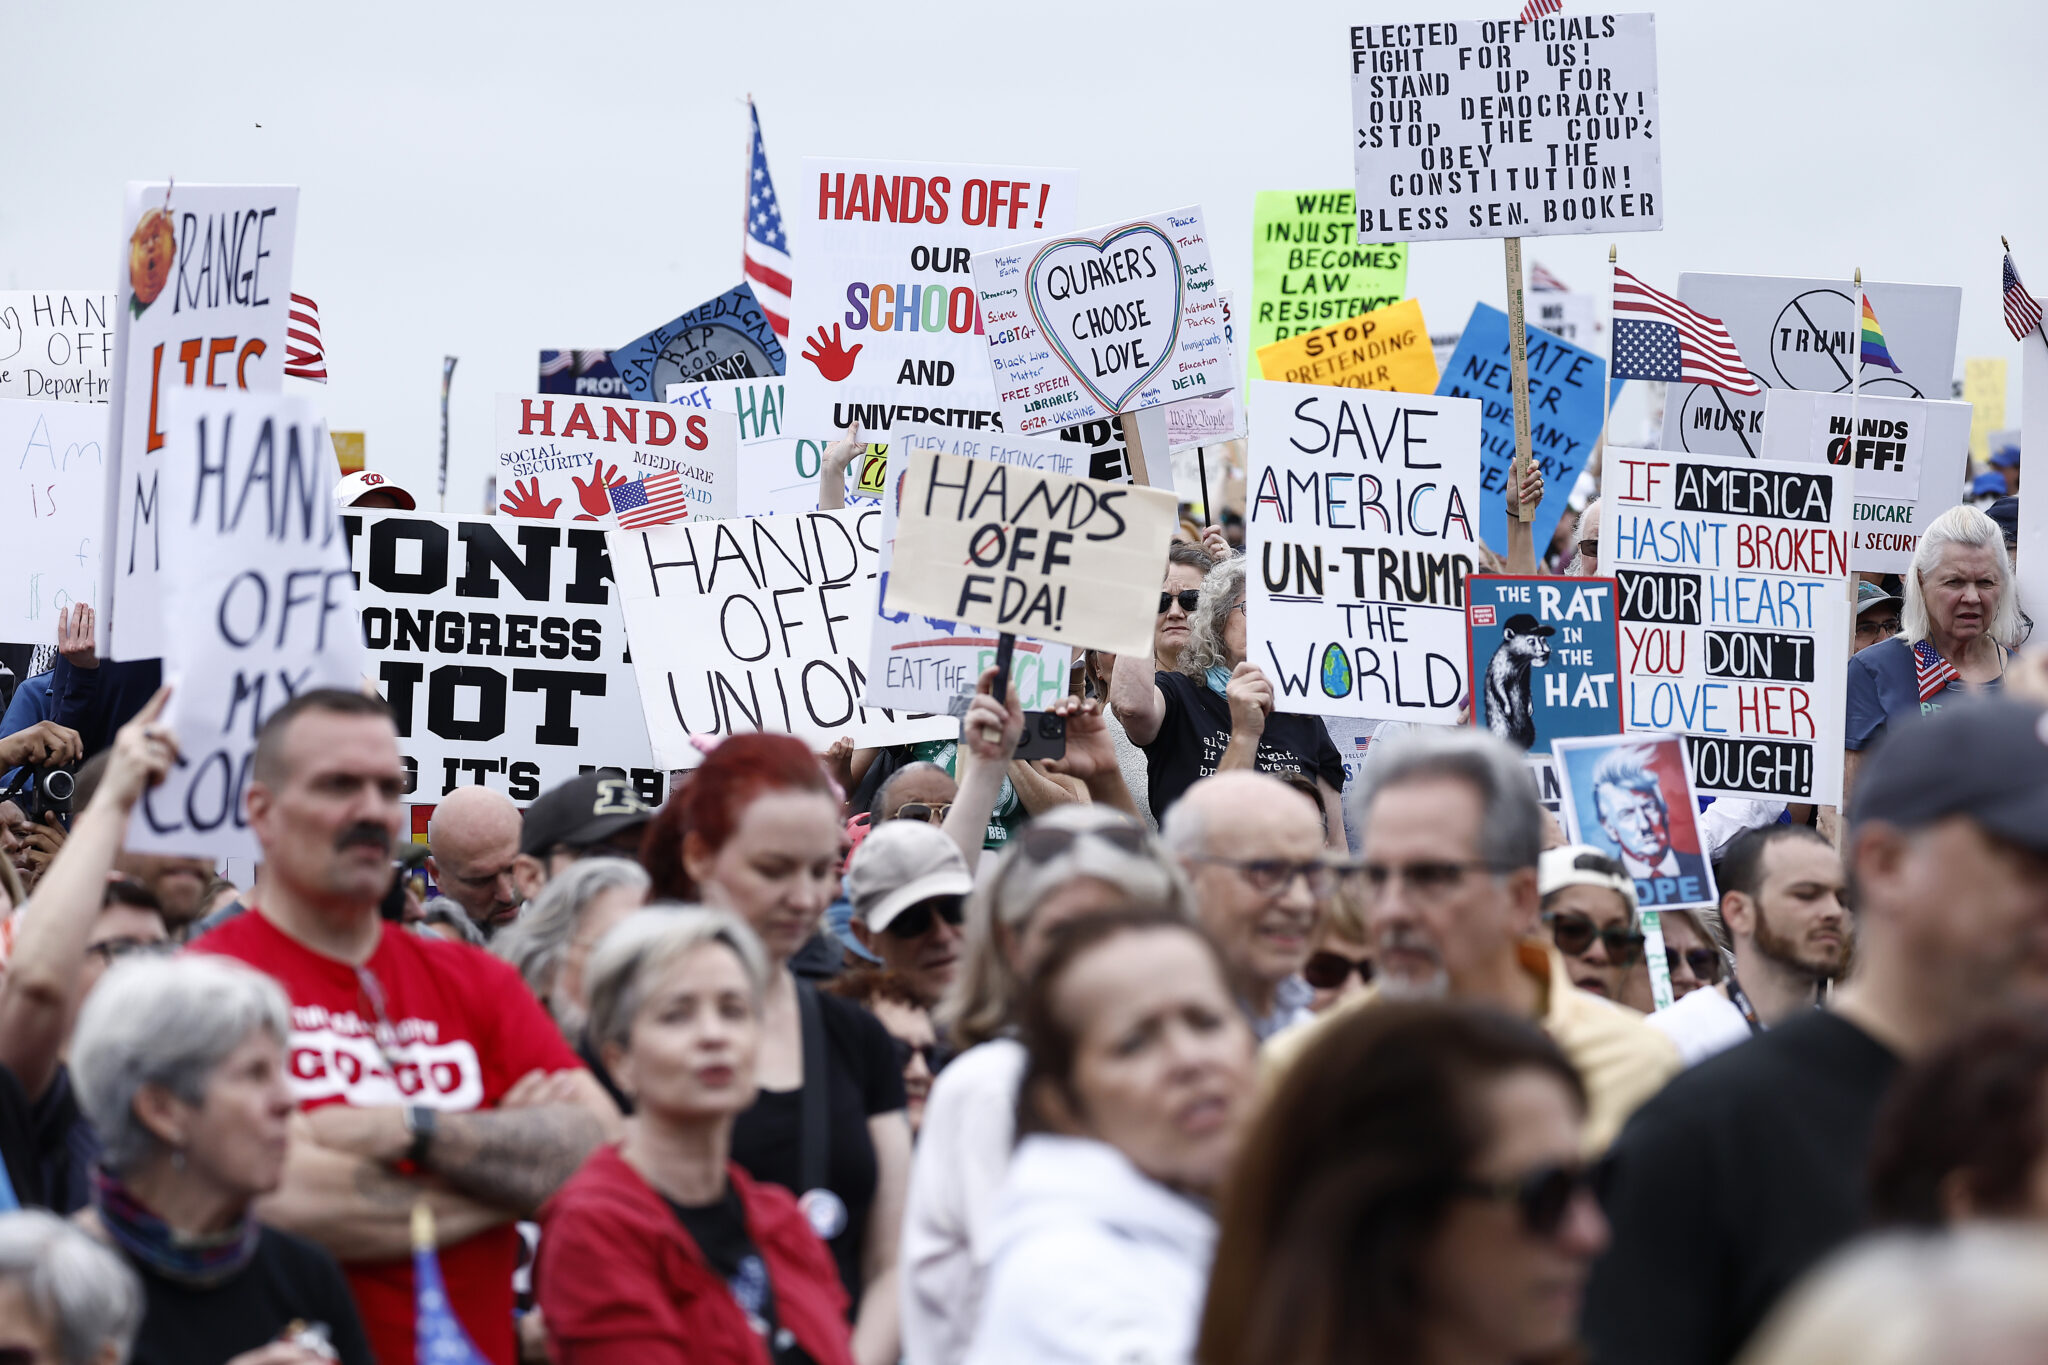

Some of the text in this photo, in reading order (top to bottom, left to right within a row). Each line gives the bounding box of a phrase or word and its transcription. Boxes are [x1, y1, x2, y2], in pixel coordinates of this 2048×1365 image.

[1350, 15, 1615, 49] ELECTED OFFICIALS
[1353, 43, 1590, 73] FIGHT FOR US!
[1370, 68, 1611, 98] STAND UP FOR
[1370, 91, 1644, 123] OUR DEMOCRACY!
[1481, 119, 1532, 144] THE
[1421, 143, 1598, 170] OBEY THE
[1390, 166, 1630, 197] CONSTITUTION!
[819, 172, 1050, 229] HANDS OFF!
[1296, 193, 1356, 215] WHE
[1360, 193, 1654, 232] BLESS SEN. BOOKER
[1167, 216, 1198, 228] Peace
[911, 245, 970, 274] OUR
[1177, 236, 1203, 249] Truth
[1289, 249, 1400, 270] BECOMES
[999, 267, 1020, 278] Earth
[1047, 246, 1157, 301] QUAKERS
[1183, 263, 1208, 277] Park
[33, 295, 118, 328] HAN
[682, 291, 785, 363] MEDICAID
[988, 309, 1018, 323] Science
[1072, 299, 1152, 340] CHOOSE
[1185, 317, 1216, 329] Parks
[48, 332, 115, 367] OFF
[658, 327, 715, 368] RIP
[989, 325, 1036, 346] LGBTQ+
[1305, 320, 1377, 356] STOP
[1781, 327, 1856, 354] TRUM
[622, 327, 671, 392] SAVE
[897, 359, 955, 387] AND
[994, 351, 1050, 371] Black Lives
[1091, 338, 1150, 378] LOVE
[1286, 329, 1418, 383] PRETENDING
[1001, 376, 1070, 402] FREE SPEECH
[1172, 373, 1207, 391] DEIA
[1024, 390, 1080, 413] LIBRARIES
[518, 399, 709, 451] HANDS
[1290, 396, 1442, 469] SAVE
[1693, 406, 1764, 434] MUSK
[1829, 416, 1909, 440] HANDS
[500, 443, 561, 467] SOCIAL
[1530, 422, 1580, 456] ANY
[513, 452, 594, 477] SECURITY
[632, 451, 714, 484] MEDICARE
[924, 454, 1128, 541] HANDS
[1252, 466, 1475, 542] AMERICA
[1618, 460, 1828, 521] IF AMERICA
[964, 521, 1074, 576] OFF
[1617, 515, 1847, 577] HASN'T BROKEN
[1865, 532, 1922, 553] SECURI
[1262, 540, 1474, 608] UN-TRUMP
[217, 567, 353, 652] OFF
[956, 574, 1067, 632] FDA!
[1496, 585, 1608, 622] THE RAT
[1618, 573, 1824, 628] YOUR HEART
[720, 583, 851, 662] OFF
[1336, 604, 1408, 642] THE
[1562, 627, 1583, 643] IN
[1558, 649, 1594, 666] THE
[1624, 626, 1811, 680] YOU DON'T
[886, 656, 931, 690] EAT
[931, 657, 967, 693] THE
[1266, 642, 1462, 708] WORLD
[1544, 672, 1615, 708] HAT
[1631, 682, 1816, 739] LOVE HER
